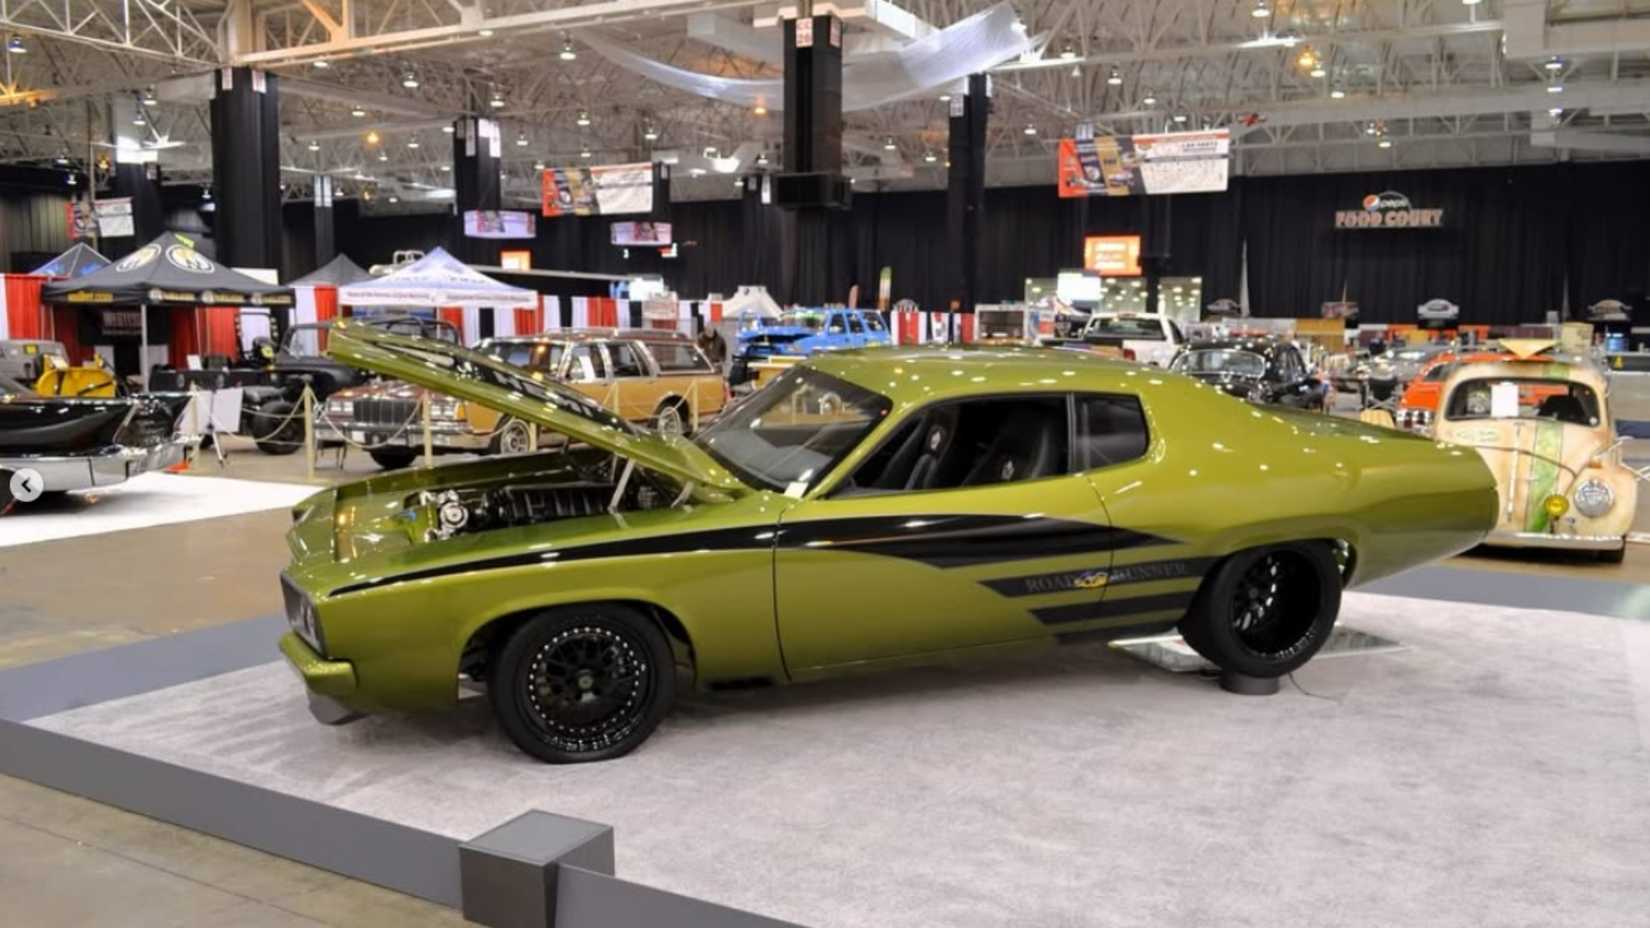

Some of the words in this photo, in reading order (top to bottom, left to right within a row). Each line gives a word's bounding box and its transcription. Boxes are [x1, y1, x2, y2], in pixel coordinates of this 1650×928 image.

[1335, 210, 1382, 228] FOOD
[1384, 208, 1443, 228] COURT
[1025, 575, 1076, 593] ROAD
